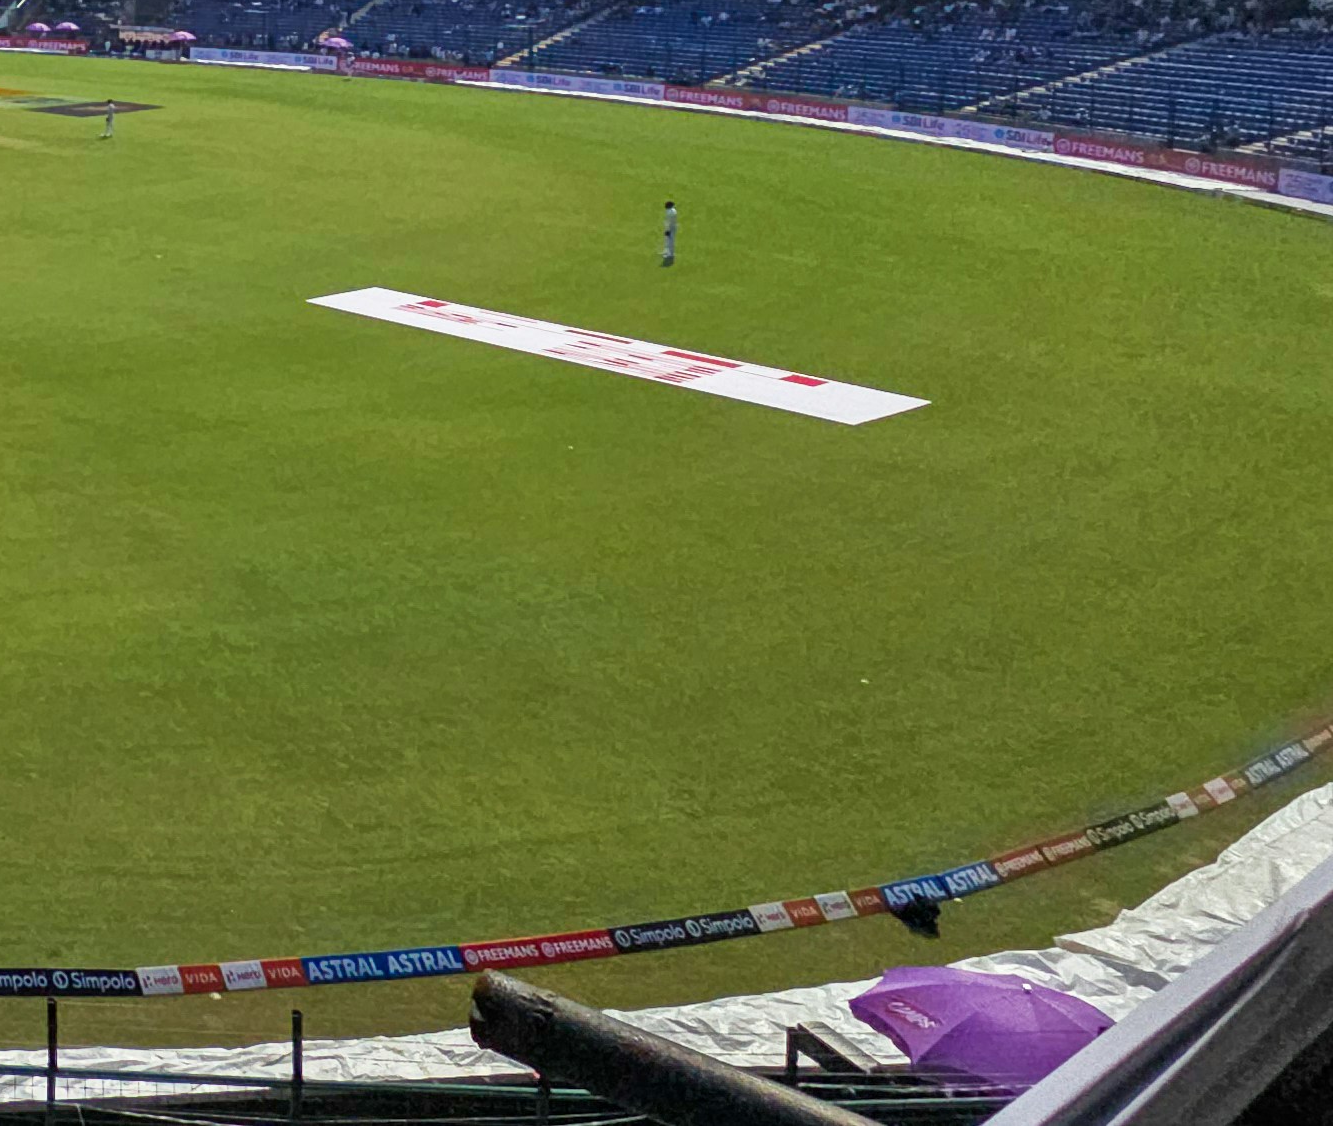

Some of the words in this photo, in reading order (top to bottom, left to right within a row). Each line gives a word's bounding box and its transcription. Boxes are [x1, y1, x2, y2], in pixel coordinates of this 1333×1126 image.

[680, 90, 743, 107] FREEMANS
[781, 103, 846, 121] FREEMANS
[1071, 140, 1144, 164] FREEMANS
[1202, 158, 1276, 185] FREEMANS
[885, 879, 944, 907] ASTRAL
[945, 863, 998, 892] ASTRAL
[790, 904, 818, 919] VIDA
[700, 915, 754, 936] Simpolo
[552, 935, 613, 954] FREEMANS
[633, 925, 685, 948] Simpolo
[477, 943, 539, 962] FREEMANS
[268, 966, 300, 980] VIDA
[307, 956, 384, 984] ASTRAL
[388, 948, 462, 975] ASTRAL
[71, 971, 136, 993] Simpolo
[186, 971, 218, 984] VIDA
